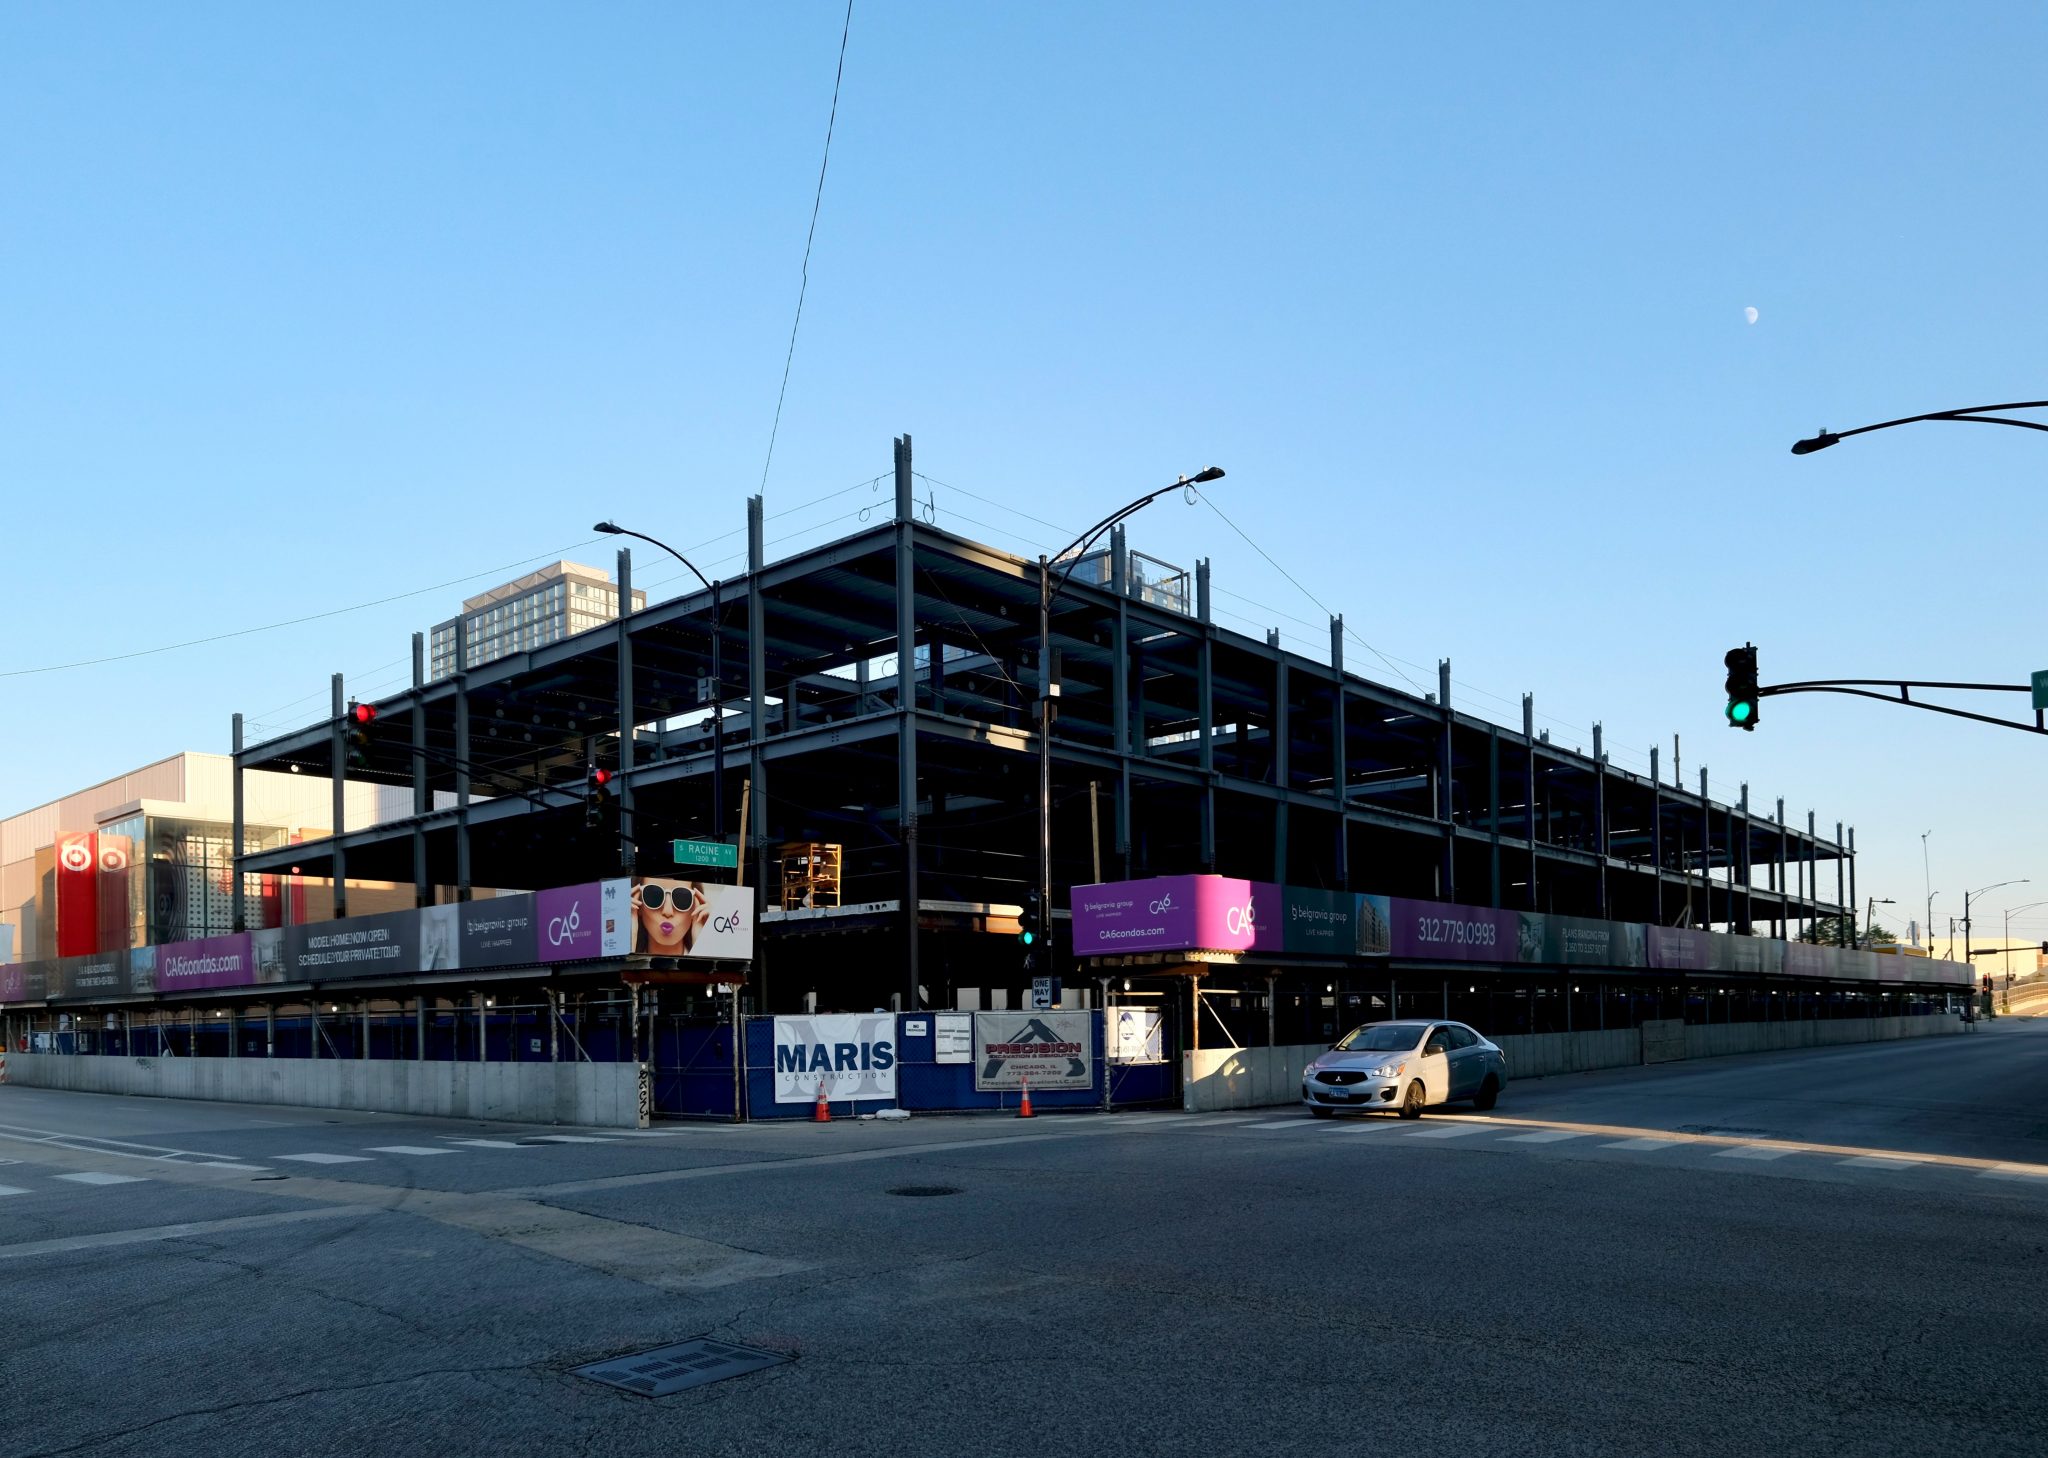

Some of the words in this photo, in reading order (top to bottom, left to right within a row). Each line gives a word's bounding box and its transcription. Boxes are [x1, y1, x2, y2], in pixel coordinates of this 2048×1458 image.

[688, 844, 719, 856] RACINE
[724, 848, 733, 856] AV
[695, 855, 709, 863] 1200
[1116, 900, 1133, 909] group
[1149, 892, 1171, 915] CA6
[713, 909, 740, 934] CA6
[1227, 895, 1256, 936] CA6
[1298, 904, 1328, 922] belgravia
[1329, 911, 1347, 925] group
[506, 916, 529, 932] group
[548, 900, 580, 946] CA6
[308, 935, 329, 949] MODEL
[330, 932, 351, 947] HOME
[351, 930, 367, 945] NOW
[368, 928, 390, 943] OPEN
[1099, 926, 1165, 940] CA6condos.com
[1305, 928, 1316, 937] LIVE
[1418, 916, 1496, 946] 312.779.0993
[1034, 979, 1049, 988] ONE
[1034, 988, 1049, 996] WAY
[985, 1042, 1082, 1054] PRECISION
[776, 1041, 894, 1073] MARIS
[785, 1072, 887, 1082] CONSTRUCTION
